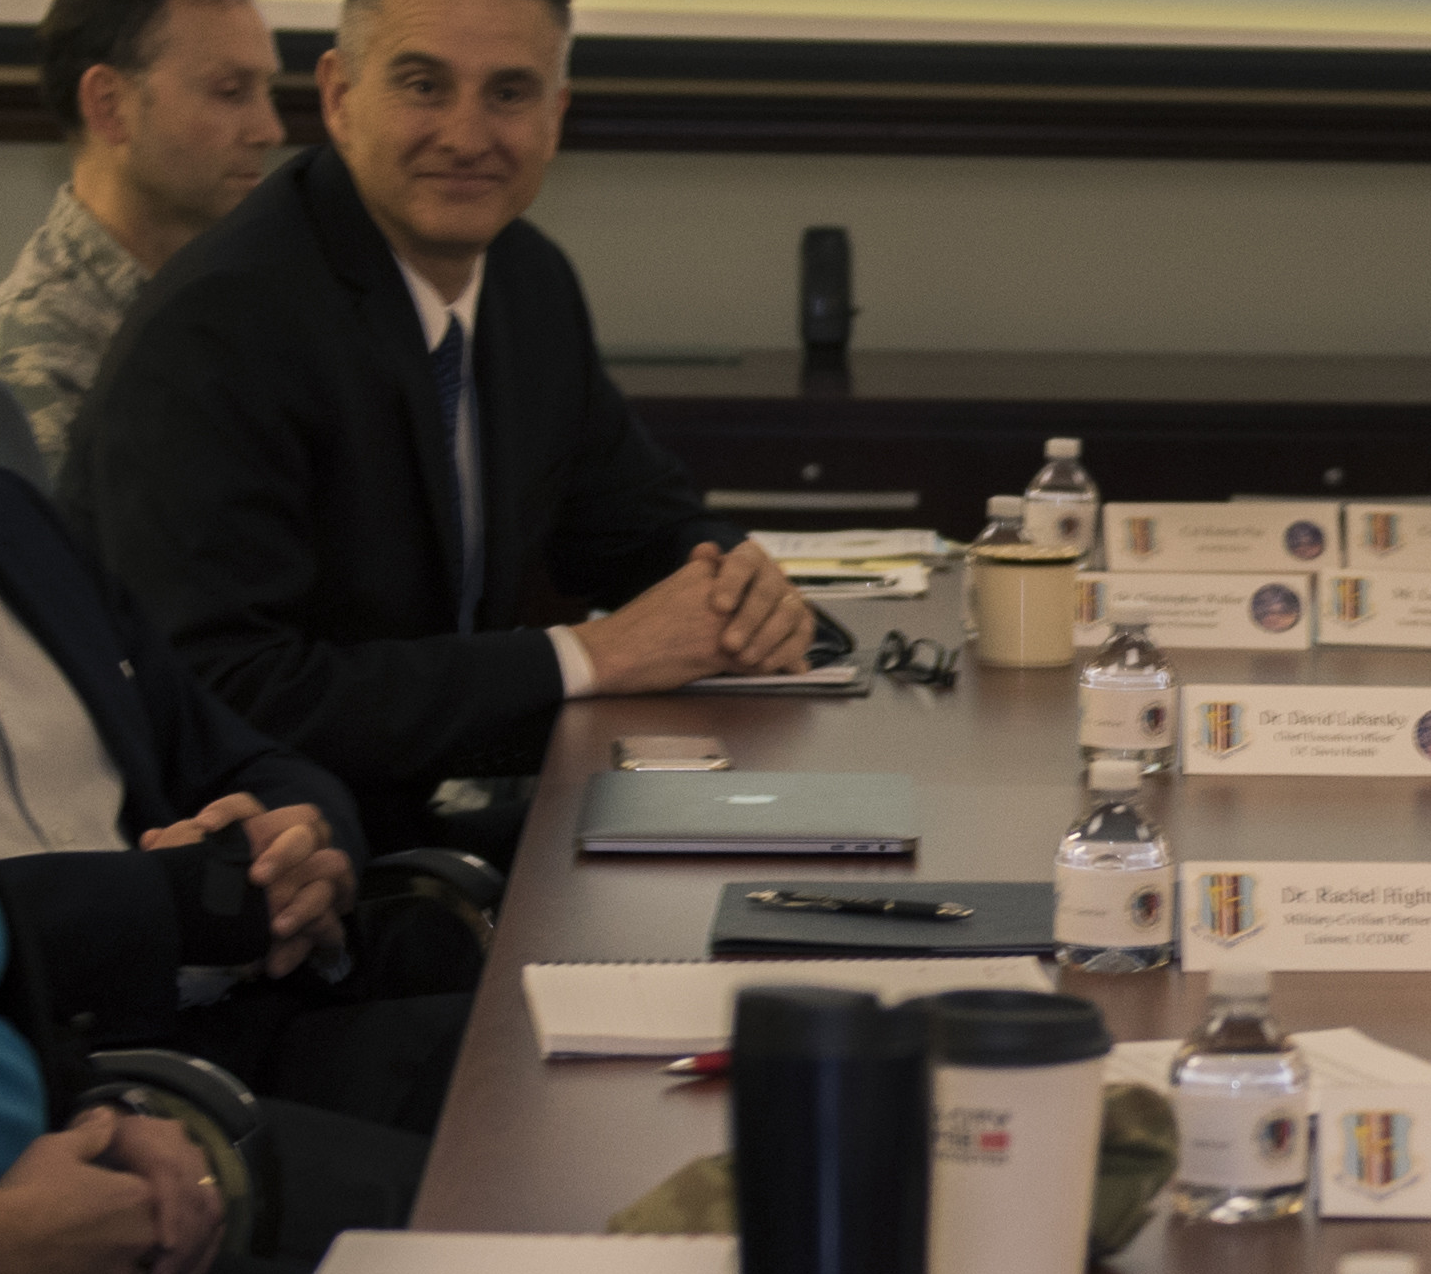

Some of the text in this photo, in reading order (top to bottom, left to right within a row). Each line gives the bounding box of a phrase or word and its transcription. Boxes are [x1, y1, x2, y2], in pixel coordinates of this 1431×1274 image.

[1259, 710, 1285, 726] Dr.
[1288, 710, 1334, 726] David
[1281, 886, 1312, 904] Dr.
[1316, 886, 1378, 905] Rachel
